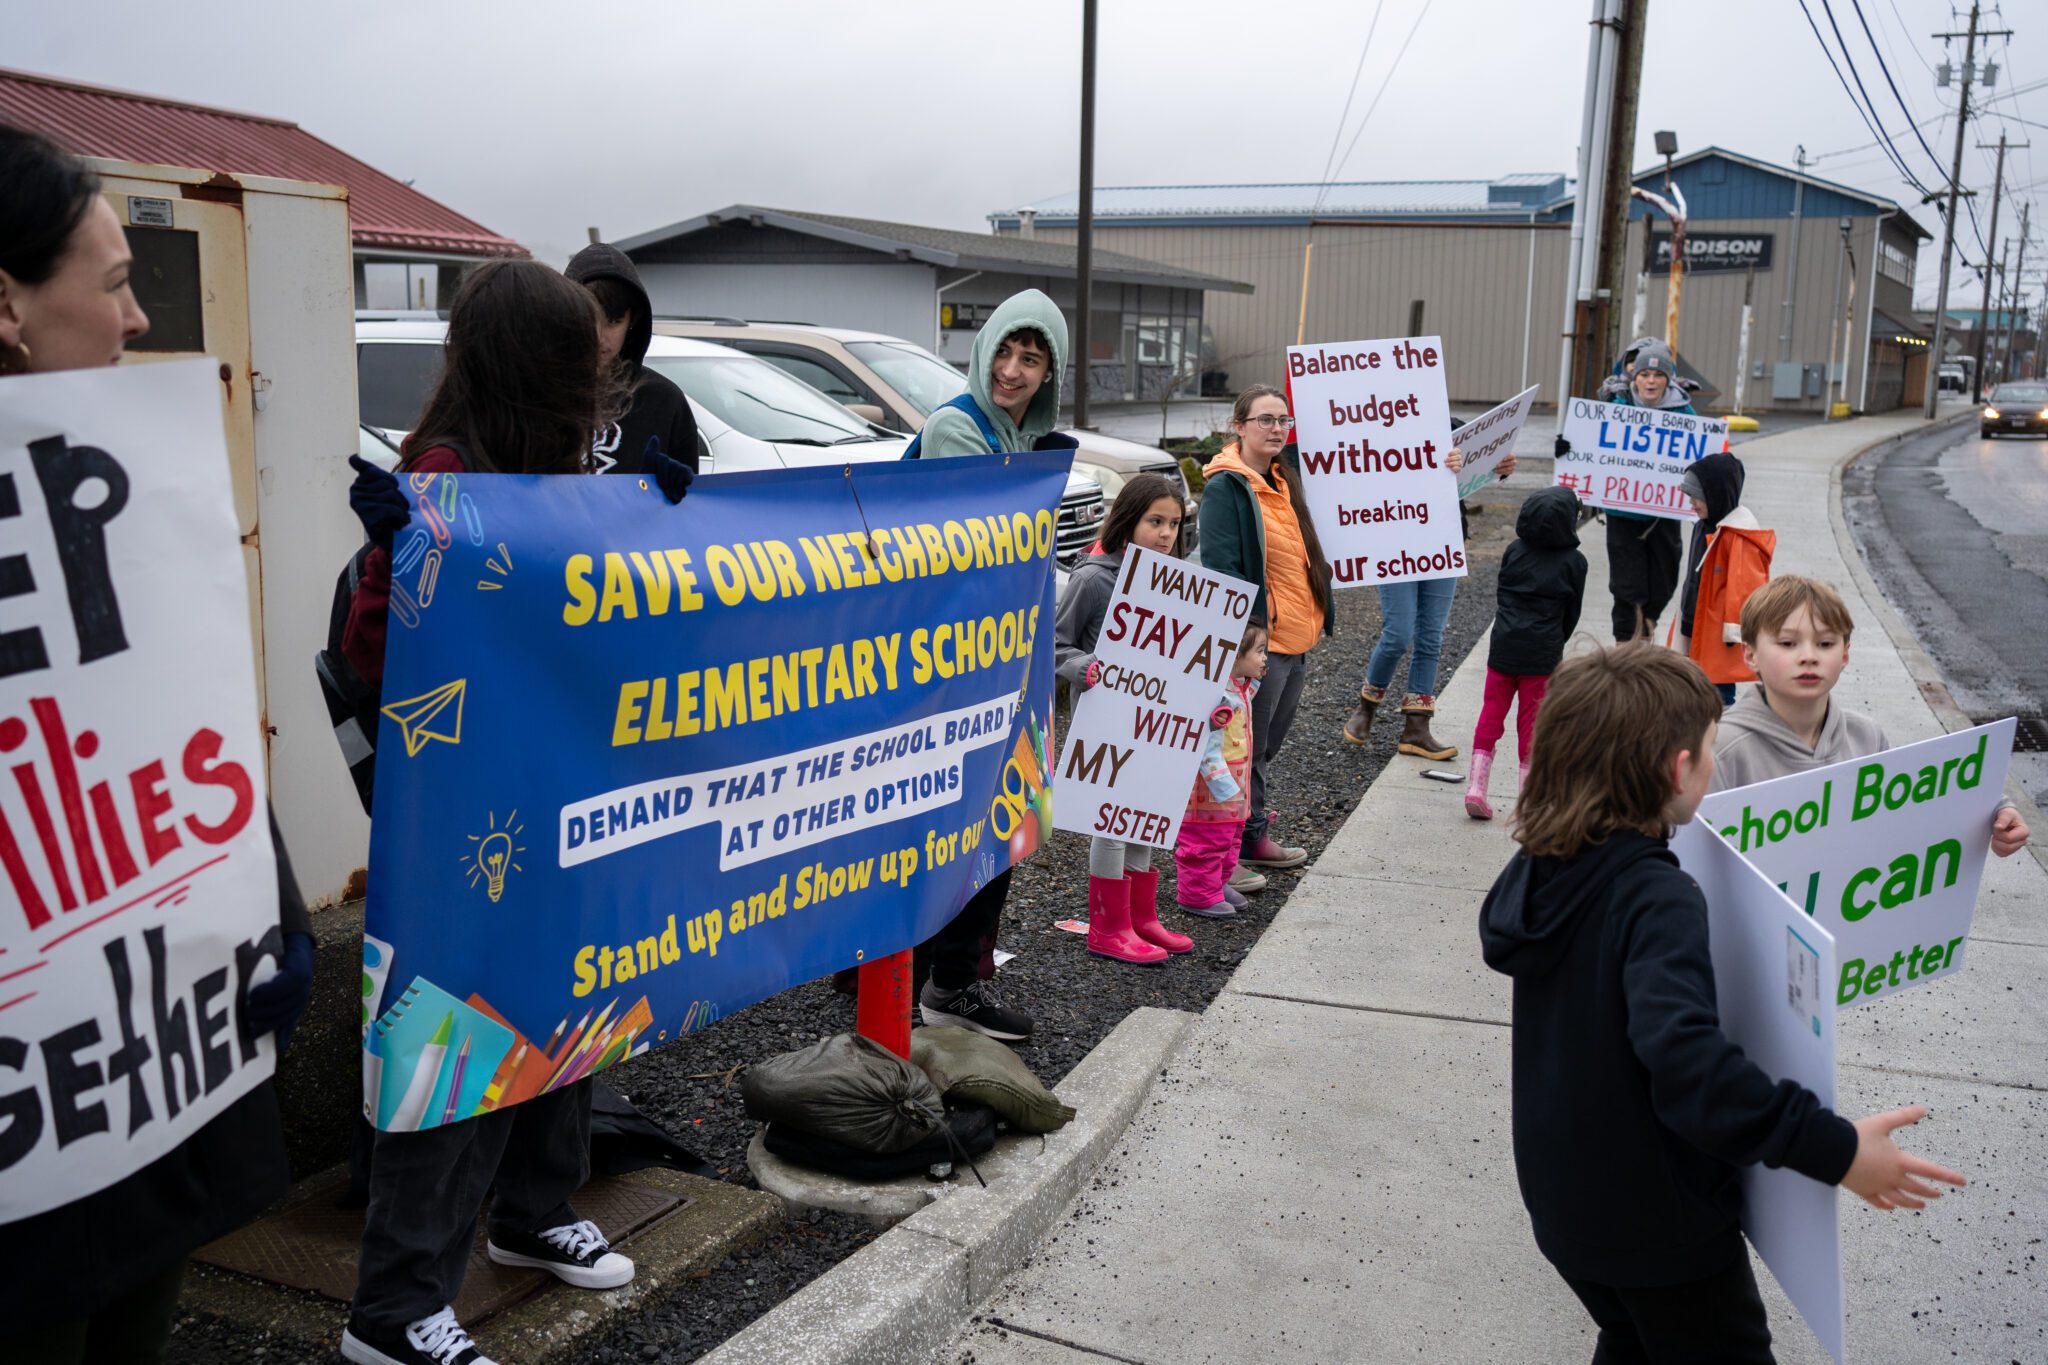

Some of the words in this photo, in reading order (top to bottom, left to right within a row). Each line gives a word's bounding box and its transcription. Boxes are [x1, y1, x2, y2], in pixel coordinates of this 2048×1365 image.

[1658, 240, 1762, 255] MDISON
[1289, 349, 1381, 378] Balance
[1392, 340, 1438, 370] the
[1329, 393, 1420, 427] budget
[1452, 400, 1521, 447] ucturing
[1574, 400, 1607, 420] OUR
[1612, 405, 1655, 426] SCHOOL
[1661, 413, 1696, 432] BOARD
[1301, 438, 1438, 475] without
[1462, 427, 1518, 468] longer
[1566, 450, 1595, 464] OUR
[1600, 454, 1655, 470] CHILDREN
[1598, 421, 1708, 461] LISTEN
[1338, 499, 1429, 526] breaking
[1558, 472, 1594, 496] #1
[1604, 476, 1688, 508] PRIORIT
[563, 548, 704, 626] SAVE
[705, 540, 806, 606] OUR
[798, 508, 1060, 592] NEIGHBORHOO
[1122, 548, 1142, 596] I
[1150, 561, 1220, 608] WANT
[1223, 588, 1249, 620] TO
[1328, 556, 1368, 583] ur
[1376, 545, 1464, 578] schools
[1106, 601, 1194, 660] STAY
[1183, 634, 1238, 684] AT
[612, 633, 901, 746] ELEMENTARY
[910, 605, 1040, 684] SCHOOLS
[1133, 706, 1205, 753] WITH
[567, 786, 693, 850] DEMAND
[707, 766, 787, 808] THAT
[797, 751, 844, 787] THE
[851, 726, 936, 771] SCHOOL
[944, 706, 1004, 746] BOARD
[1065, 738, 1135, 788] MY
[1851, 733, 1989, 822] Board
[726, 820, 764, 857] AT
[773, 794, 856, 841] OTHER
[865, 765, 959, 814] OPTIONS
[1094, 802, 1171, 845] SISTER
[1840, 838, 1962, 923] can
[573, 914, 680, 998] Stand
[686, 909, 722, 957] up
[729, 874, 787, 934] and
[793, 858, 874, 910] Show
[880, 847, 918, 888] up
[925, 830, 958, 871] for
[962, 818, 986, 855] ou
[1836, 935, 1964, 1006] Better
